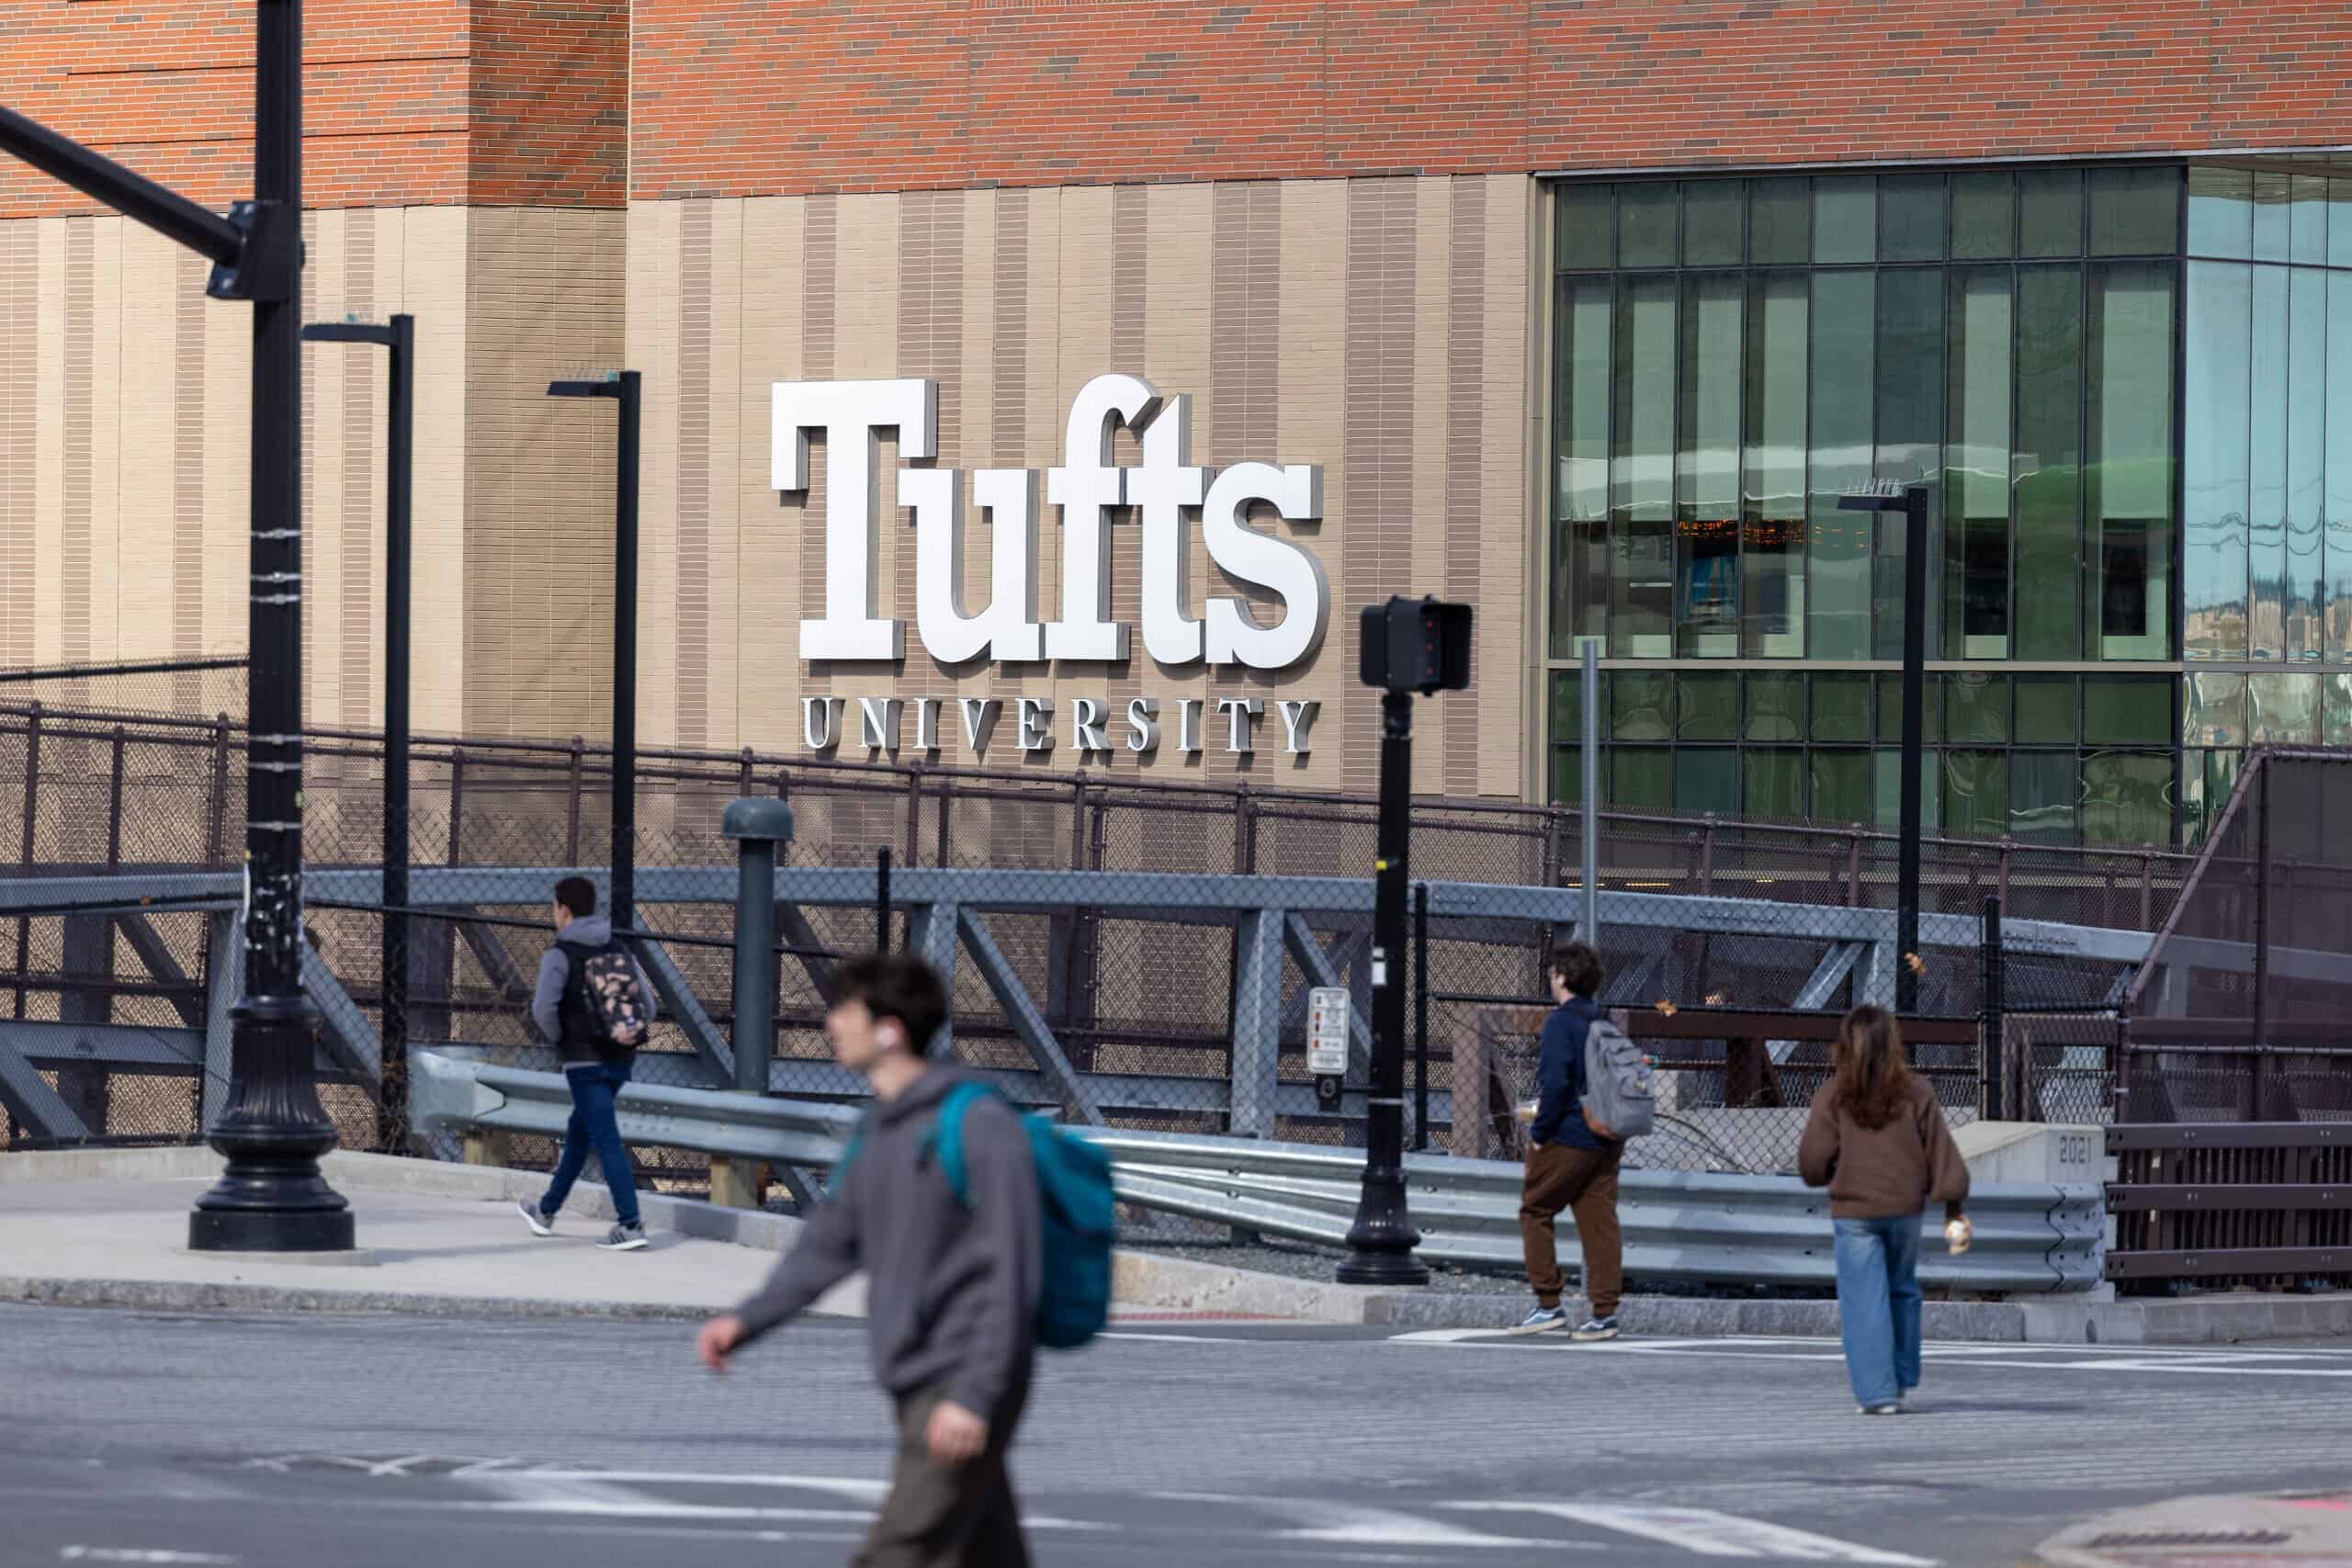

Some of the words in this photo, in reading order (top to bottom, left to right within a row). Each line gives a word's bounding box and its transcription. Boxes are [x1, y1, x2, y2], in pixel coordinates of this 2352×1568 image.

[772, 374, 1329, 668] Tufts
[802, 697, 1320, 753] UNIVERSITY
[2060, 1136, 2091, 1164] 2021
